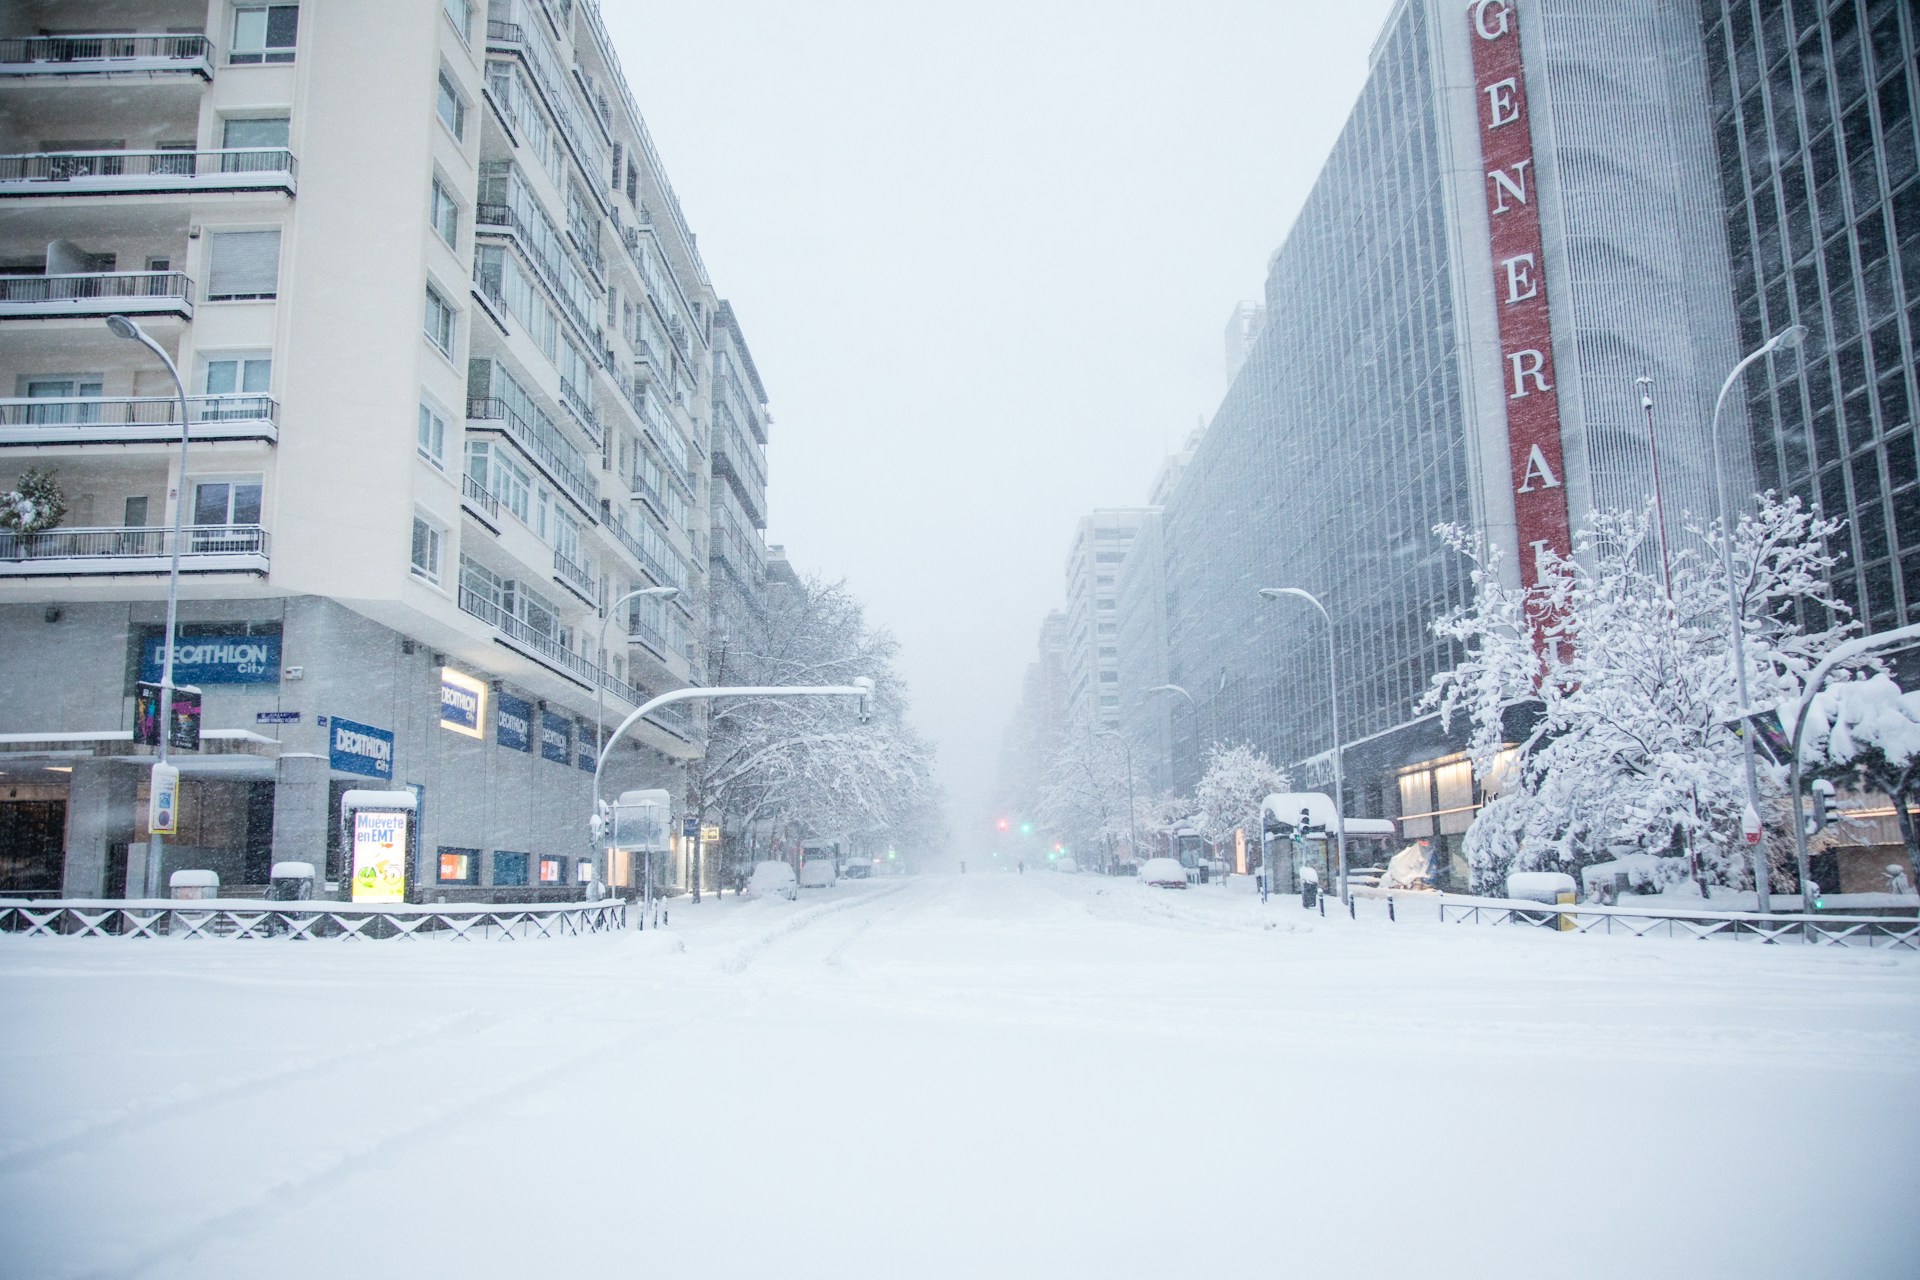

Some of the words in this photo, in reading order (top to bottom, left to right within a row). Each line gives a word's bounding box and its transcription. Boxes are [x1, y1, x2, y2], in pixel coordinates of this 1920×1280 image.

[155, 645, 267, 664] DECATHLON
[237, 663, 265, 674] City
[441, 686, 475, 713] DECATHLON
[498, 710, 528, 735] DECATHLON
[336, 727, 391, 761] DECATHLON
[358, 815, 404, 829] Muévete
[357, 831, 370, 842] en
[372, 829, 395, 842] EMT
